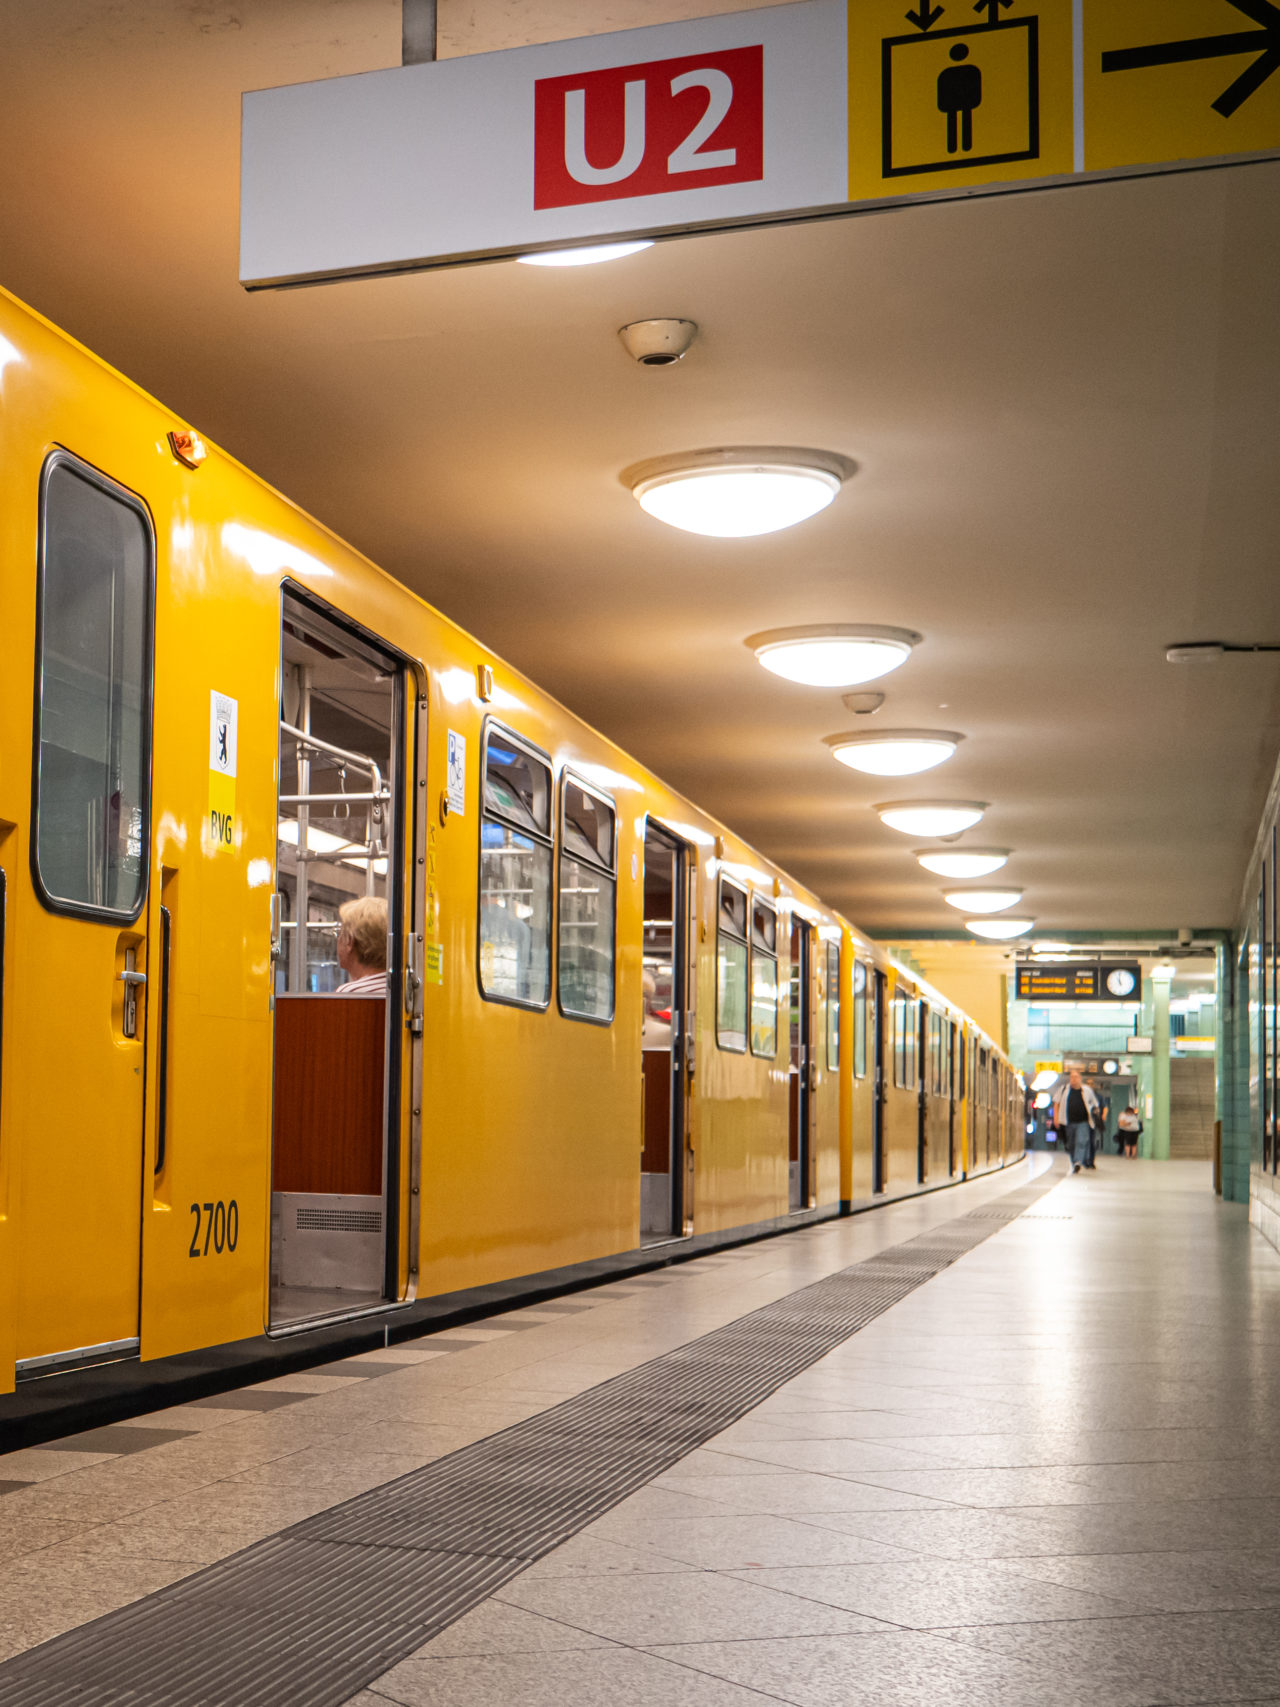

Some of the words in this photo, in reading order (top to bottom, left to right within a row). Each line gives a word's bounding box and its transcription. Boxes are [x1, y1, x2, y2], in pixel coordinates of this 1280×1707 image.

[565, 68, 733, 185] U2
[211, 810, 231, 844] BVG
[189, 1200, 238, 1258] 2700
